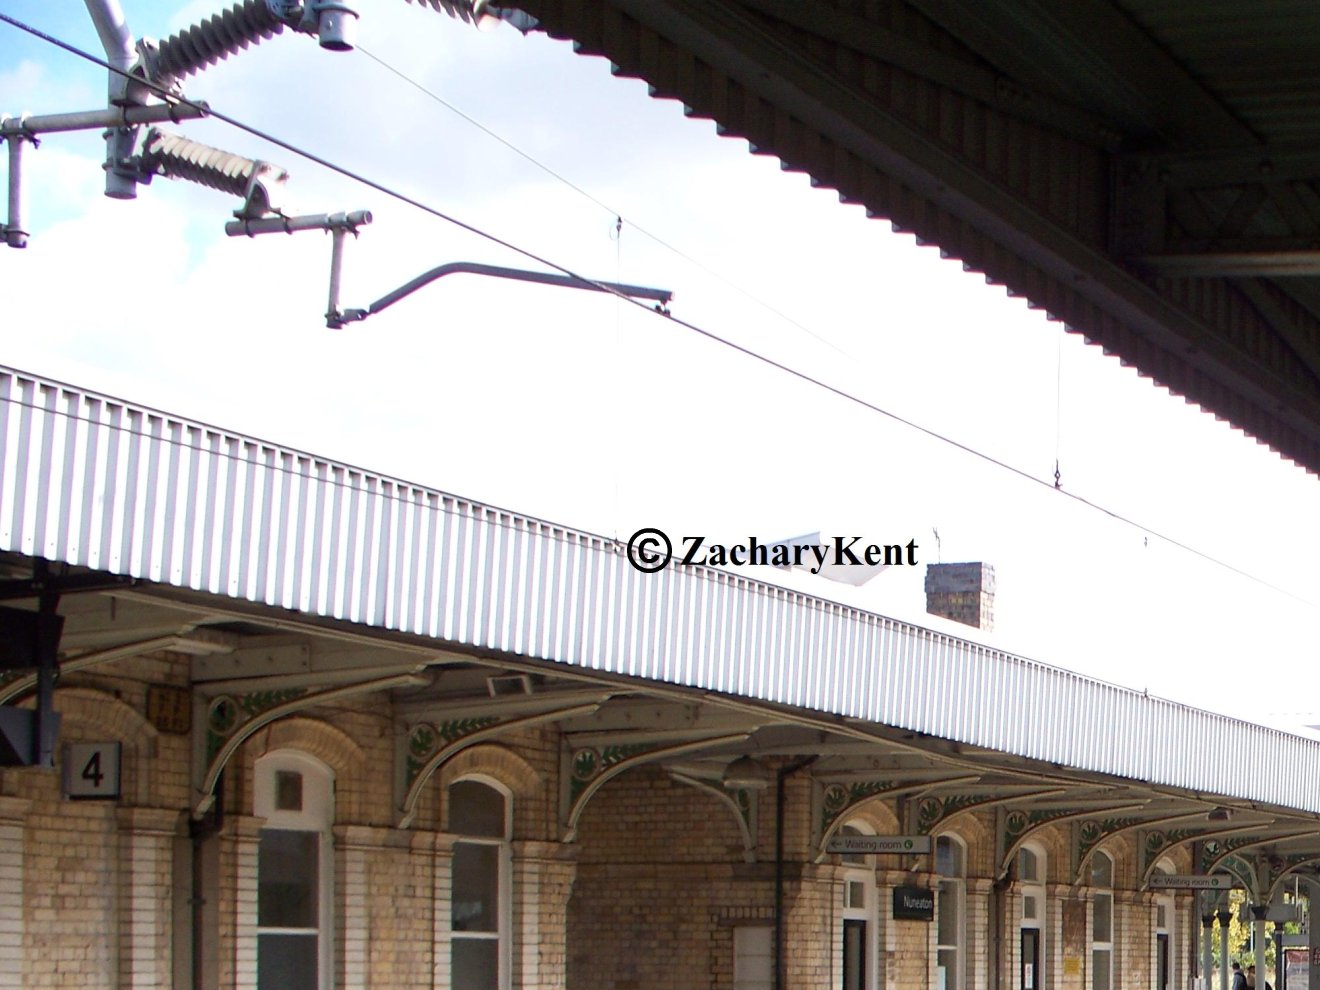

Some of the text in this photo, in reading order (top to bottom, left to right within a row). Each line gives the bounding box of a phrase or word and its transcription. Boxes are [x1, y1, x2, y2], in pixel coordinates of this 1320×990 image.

[81, 751, 104, 788] 4
[845, 840, 902, 851] Waiting room
[1164, 877, 1190, 886] Waiting
[903, 895, 933, 908] Nuneaton
